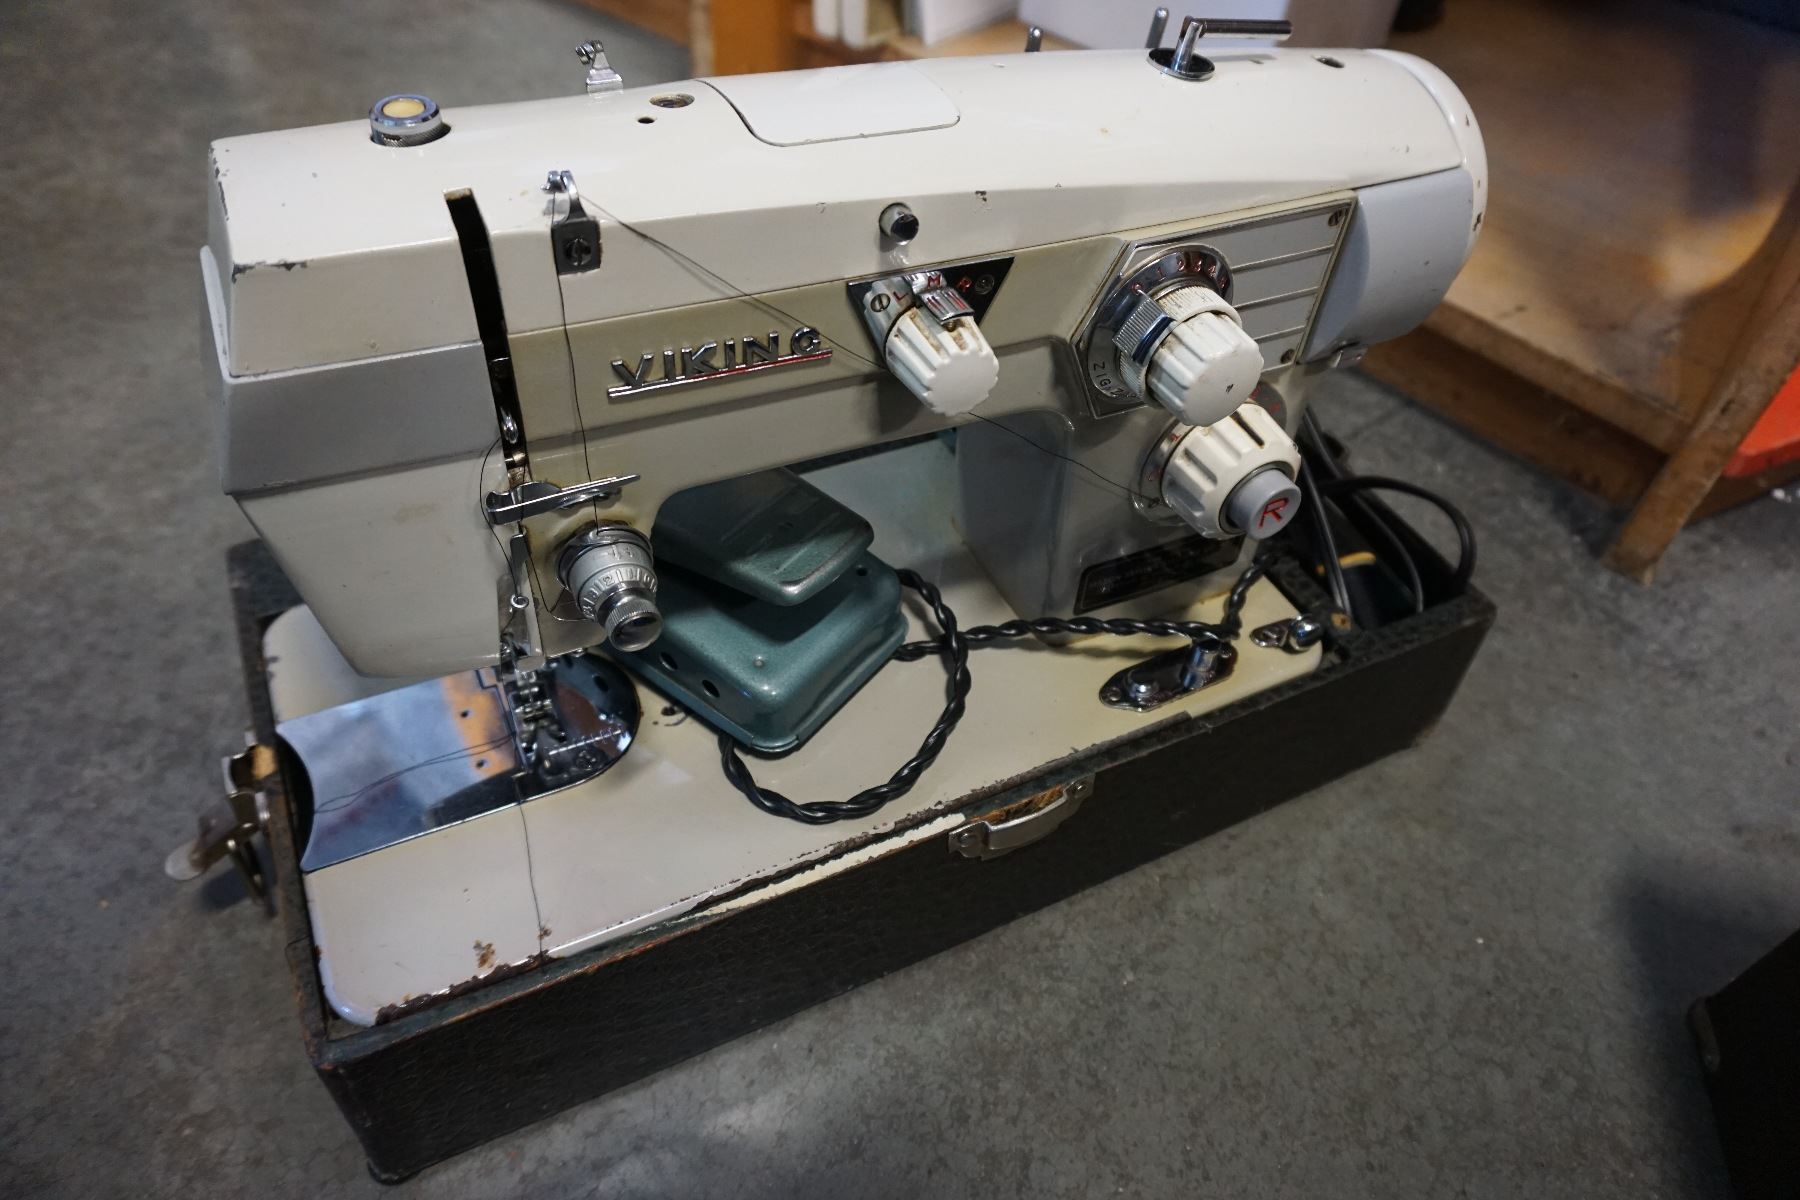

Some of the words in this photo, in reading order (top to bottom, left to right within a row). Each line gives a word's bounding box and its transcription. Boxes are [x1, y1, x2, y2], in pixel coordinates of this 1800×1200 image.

[927, 274, 941, 289] M
[611, 326, 822, 388] VIKING
[1258, 497, 1290, 529] R
